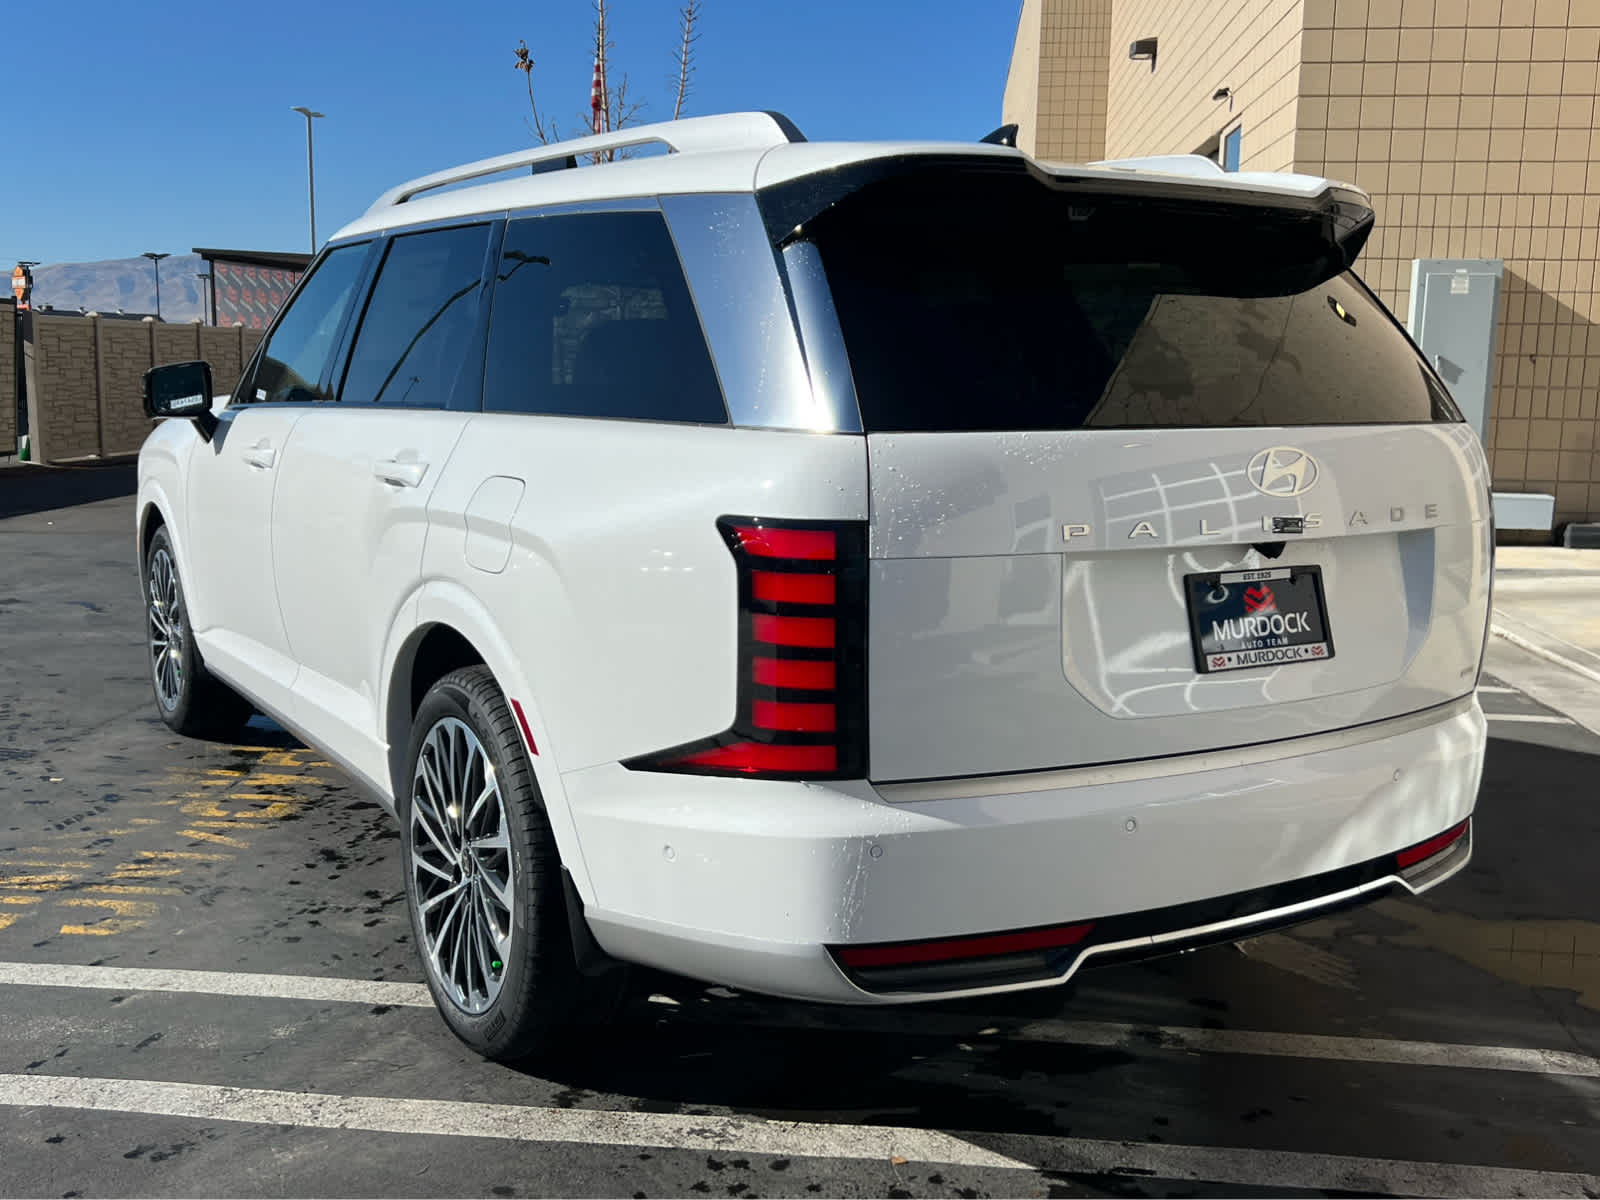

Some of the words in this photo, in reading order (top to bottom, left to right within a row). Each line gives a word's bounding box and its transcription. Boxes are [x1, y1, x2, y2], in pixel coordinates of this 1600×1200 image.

[1062, 503, 1439, 542] PALISADE
[1212, 612, 1311, 641] MURDOCK
[1241, 640, 1264, 649] AUTO
[1267, 637, 1289, 646] TEAM
[1236, 647, 1303, 665] MURDOCK
